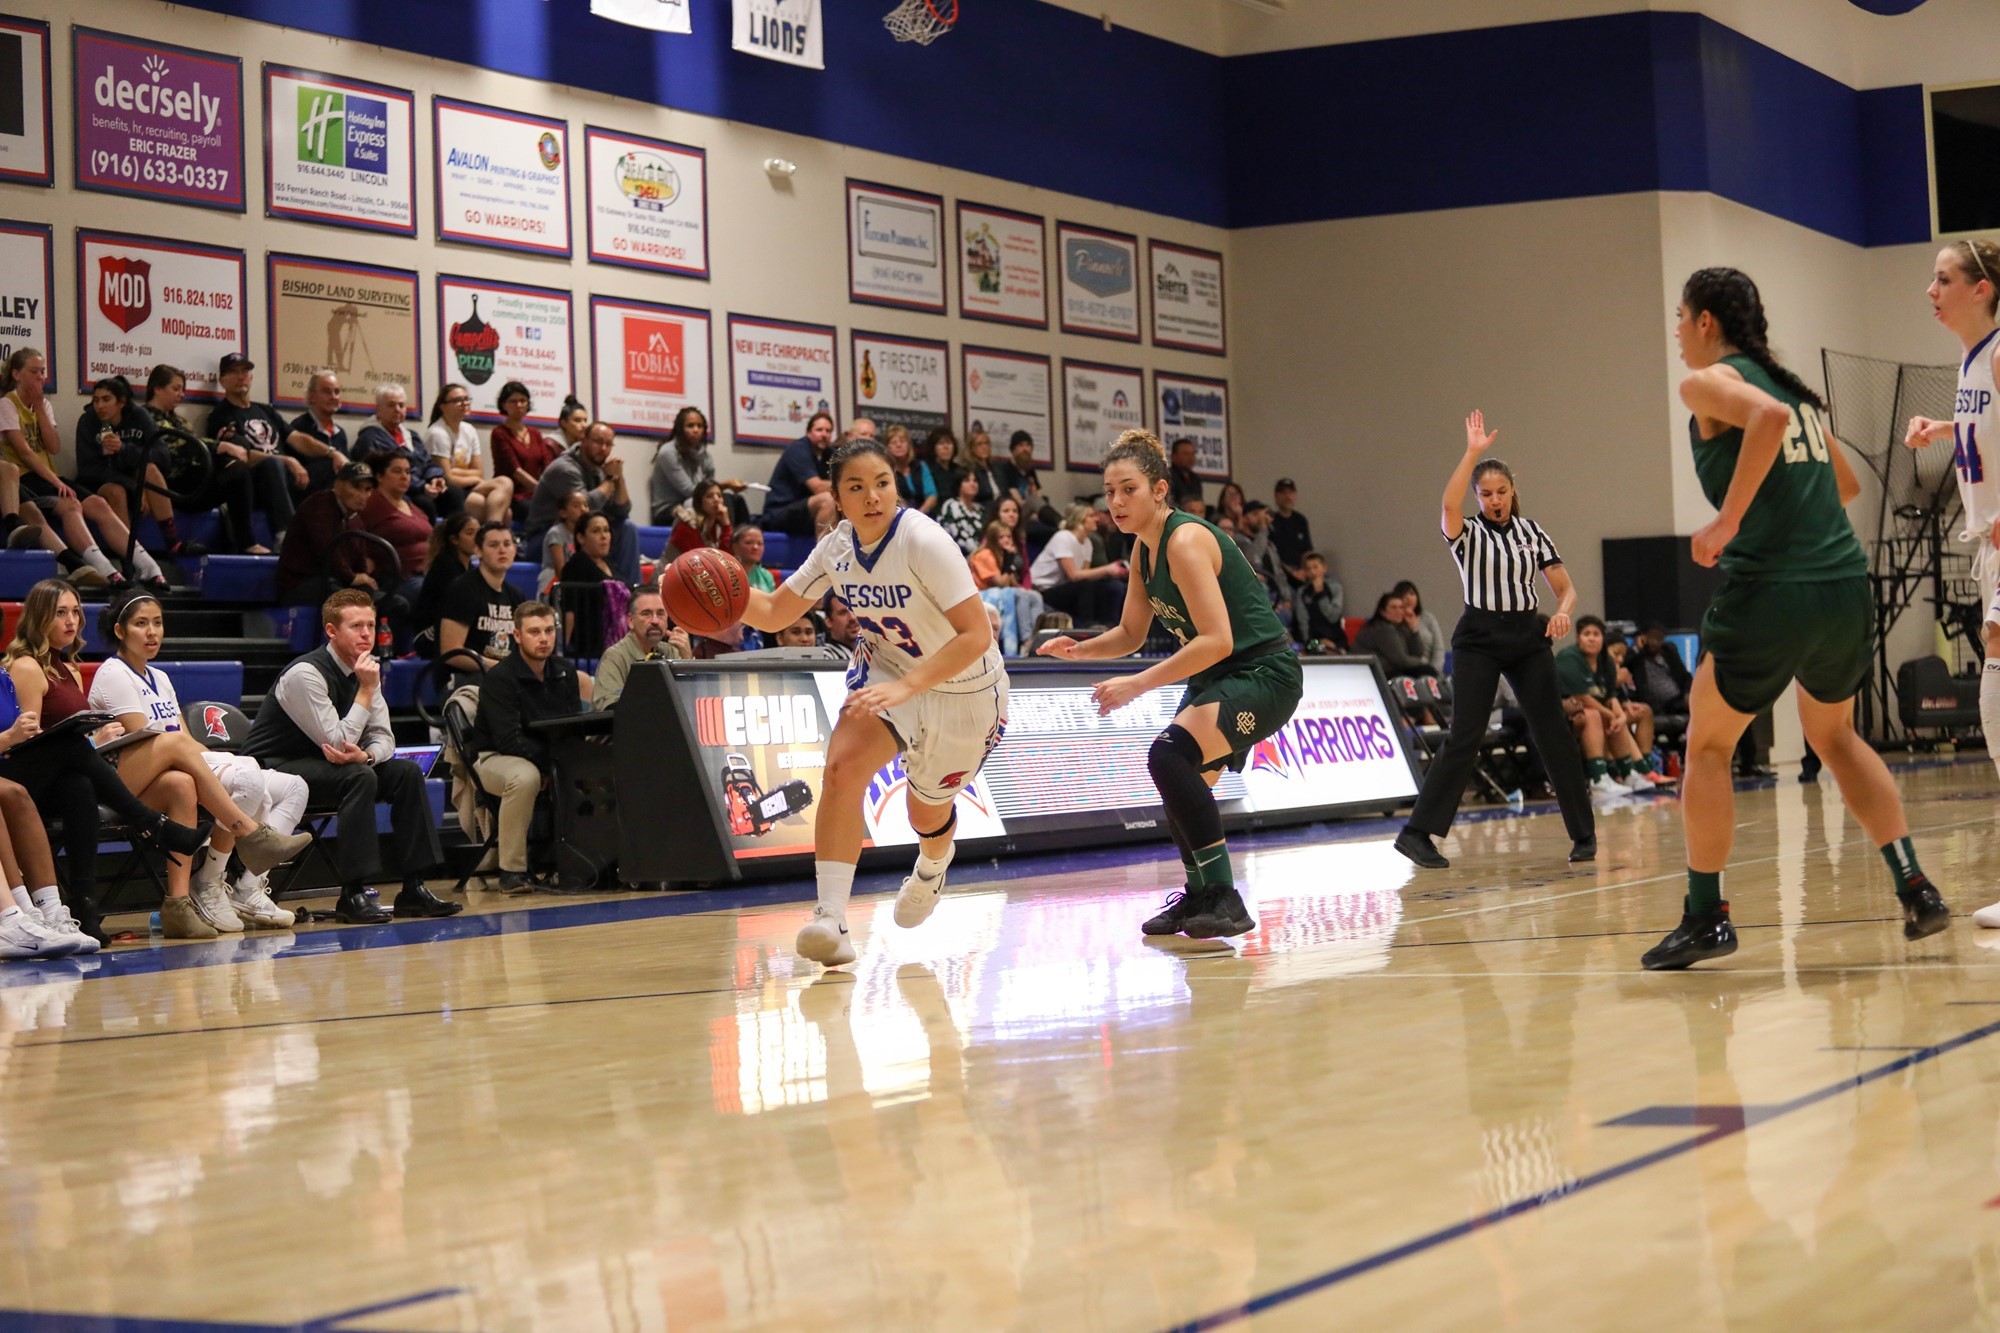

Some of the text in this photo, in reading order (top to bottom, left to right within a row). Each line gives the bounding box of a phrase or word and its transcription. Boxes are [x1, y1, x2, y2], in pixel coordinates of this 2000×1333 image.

[95, 65, 220, 135] decisely
[92, 114, 222, 148] benefits, hr, recruiting, payroll
[347, 125, 386, 147] Express
[129, 138, 197, 161] ERIC FRAZER
[447, 148, 489, 171] AVALON
[91, 149, 228, 191] (916) 633-0337
[351, 171, 388, 186] LINCOLN
[490, 164, 520, 179] PRINTING
[527, 171, 560, 185] GRAPHICS
[465, 209, 546, 234] GO WARRIORS!
[612, 236, 627, 251] GO
[104, 271, 145, 309] MOD
[282, 279, 411, 307] BISHOP LAND SURVEYING
[1157, 273, 1188, 295] Sierra
[0, 296, 39, 320] LEY
[163, 286, 233, 310] 916.824.1052
[161, 317, 236, 342] MODpizza.com
[98, 341, 152, 356] speed style pizza
[735, 339, 831, 364] NEW LIFE CHIROPRACTIC
[91, 362, 108, 374] 5400
[110, 363, 139, 379] Crossings
[185, 370, 208, 383] ocklin,
[458, 354, 493, 370] PIZZA
[628, 351, 680, 376] TOBIAS
[880, 351, 938, 375] FIRESTAR
[890, 380, 930, 402] YOGA
[1955, 389, 1991, 414] SSUP
[1102, 408, 1140, 422] FARMERS
[1781, 402, 1829, 464] 20
[150, 701, 177, 720] JESS
[1273, 714, 1395, 782] WARRIORS
